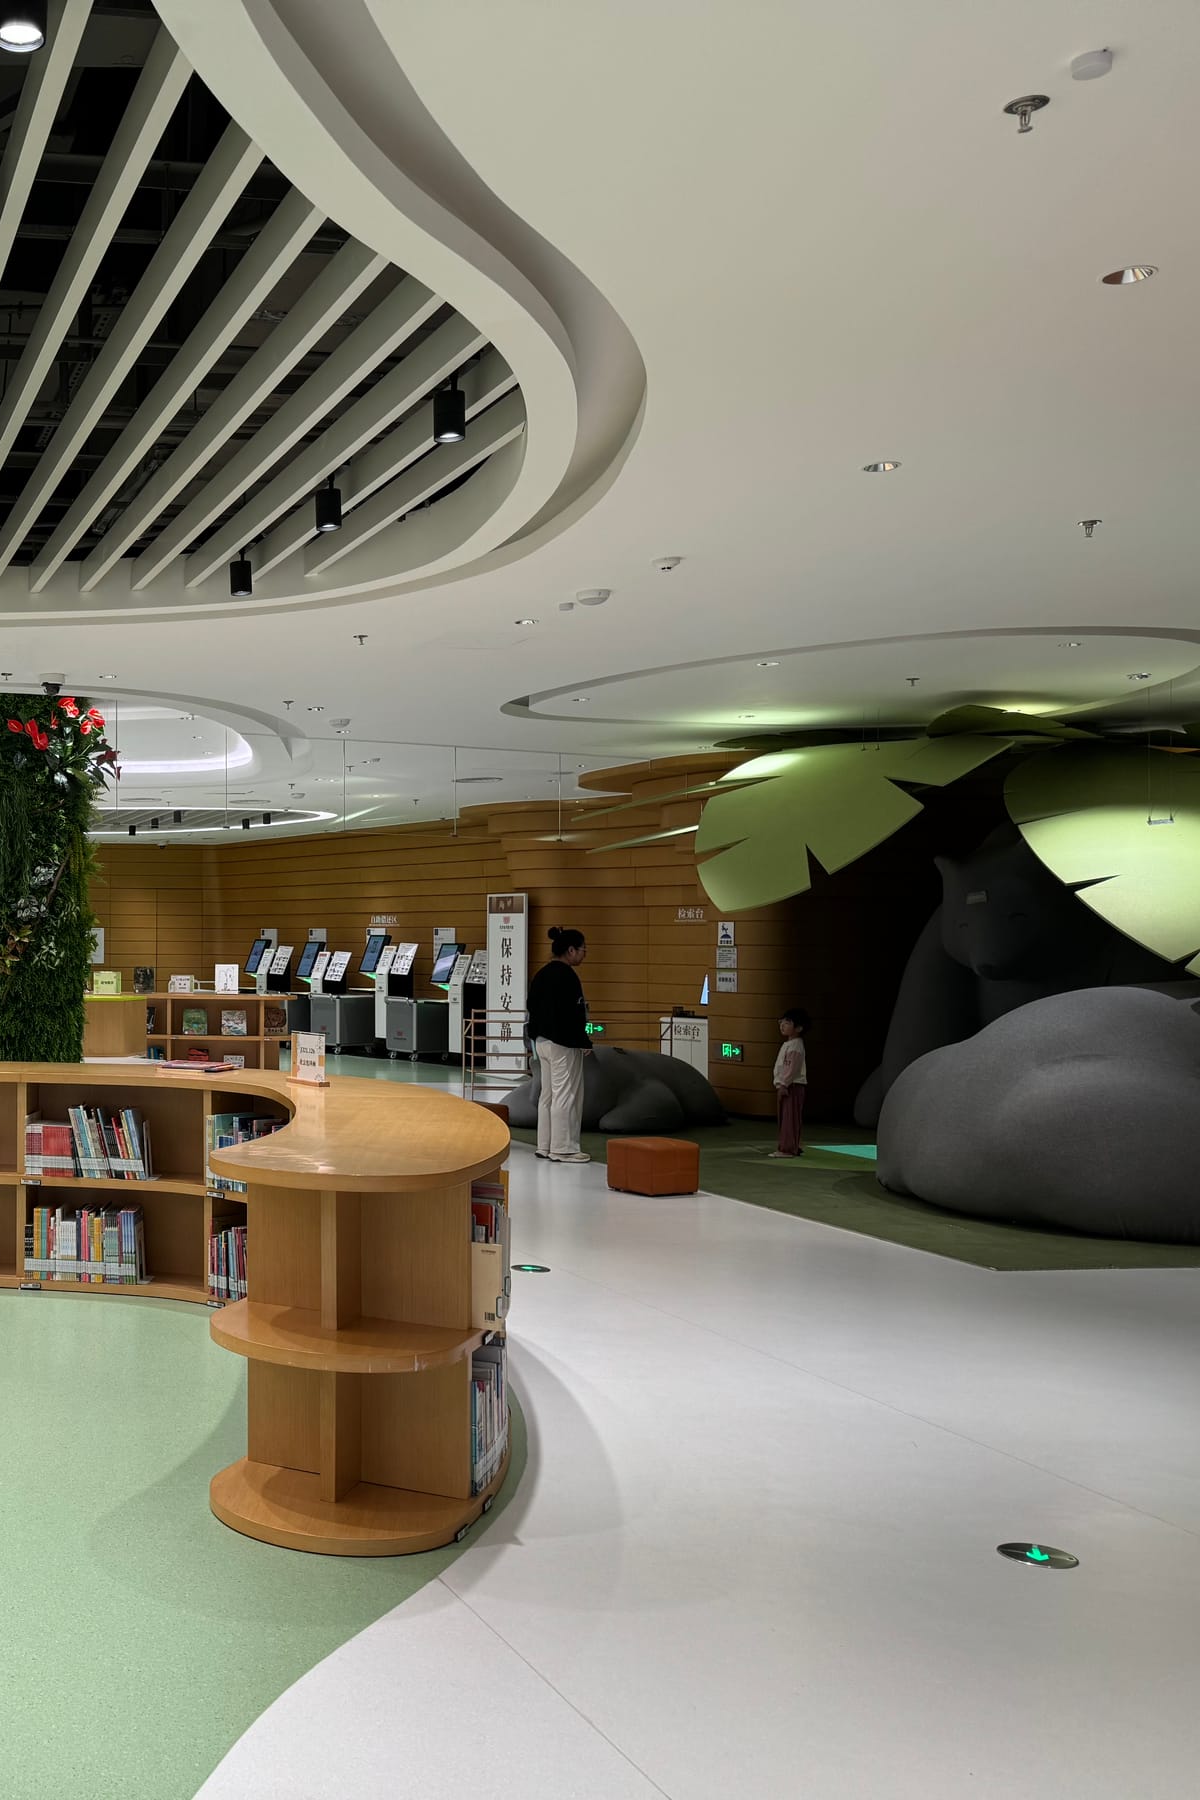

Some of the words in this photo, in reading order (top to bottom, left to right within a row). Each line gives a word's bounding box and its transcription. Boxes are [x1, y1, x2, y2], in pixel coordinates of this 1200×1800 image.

[678, 908, 704, 919] 检索台
[500, 937, 512, 1042] 保持安静
[673, 1025, 700, 1038] 检索台
